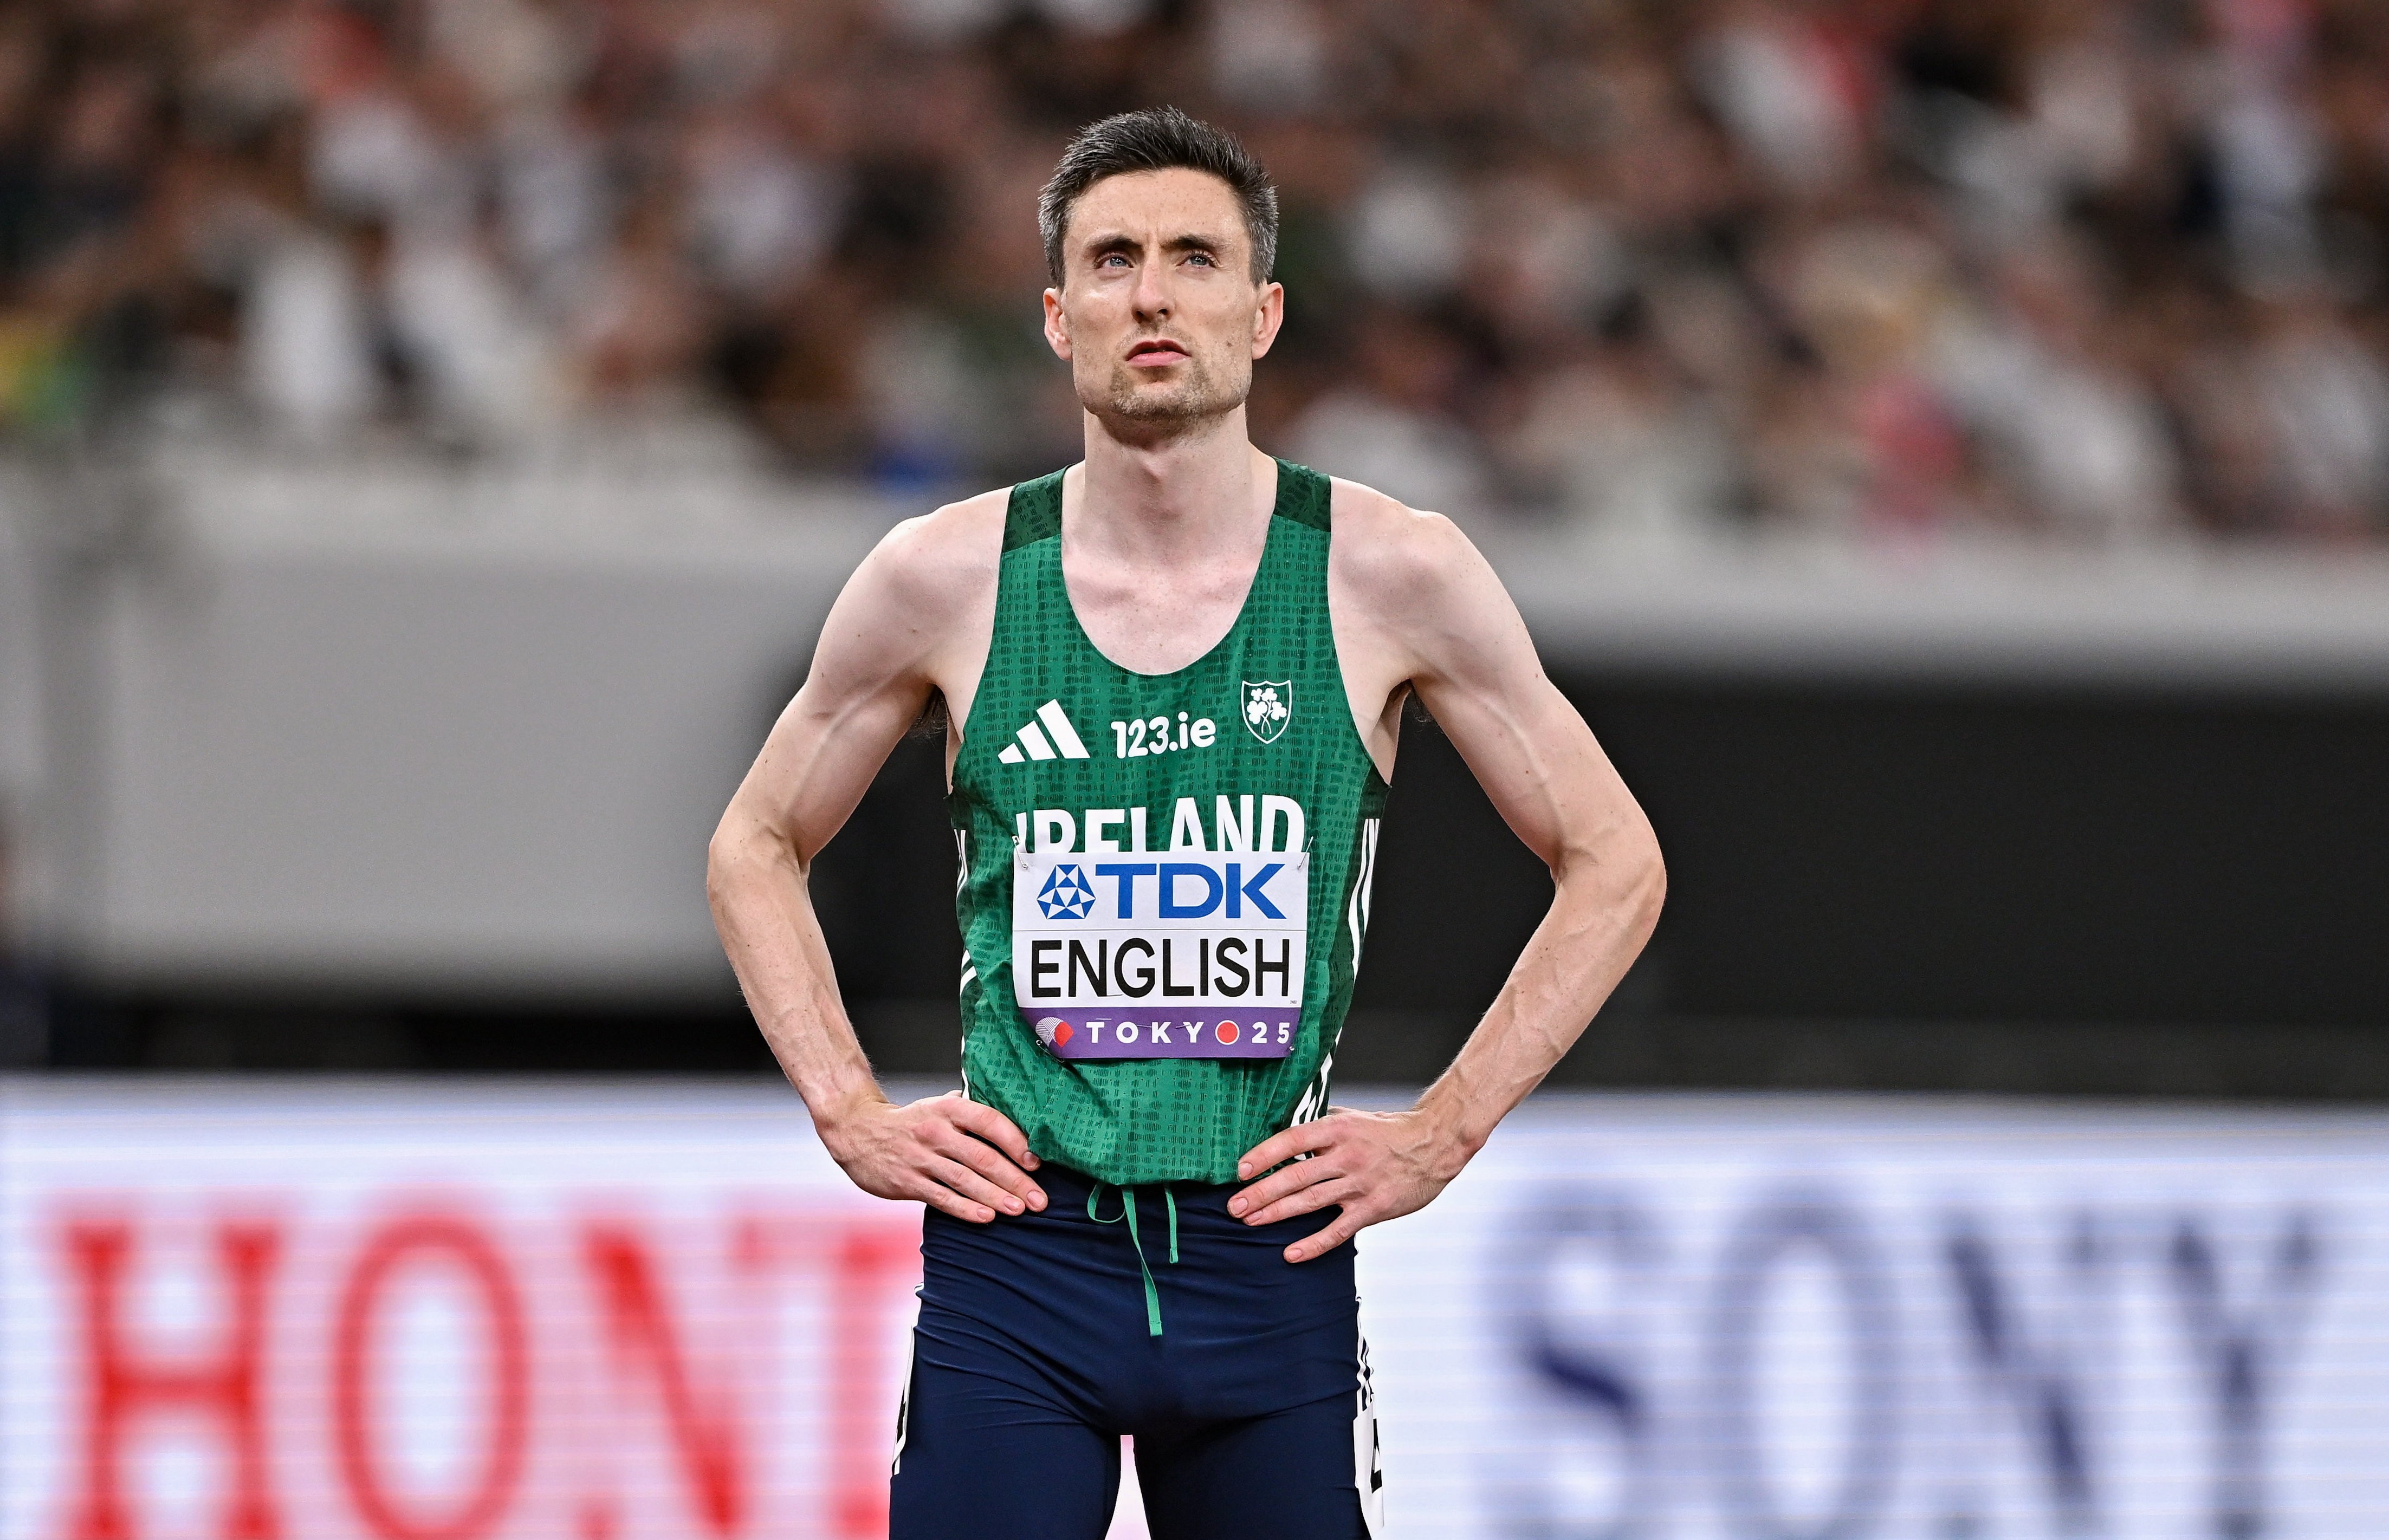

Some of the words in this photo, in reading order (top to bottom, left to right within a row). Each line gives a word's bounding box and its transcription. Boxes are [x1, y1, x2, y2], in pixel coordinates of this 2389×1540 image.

[1111, 711, 1216, 758] 123.ie
[1095, 863, 1287, 919] TDK
[1032, 938, 1290, 998] ENGLISH
[1252, 1022, 1290, 1044] 25
[1479, 1184, 2327, 1540] SONY
